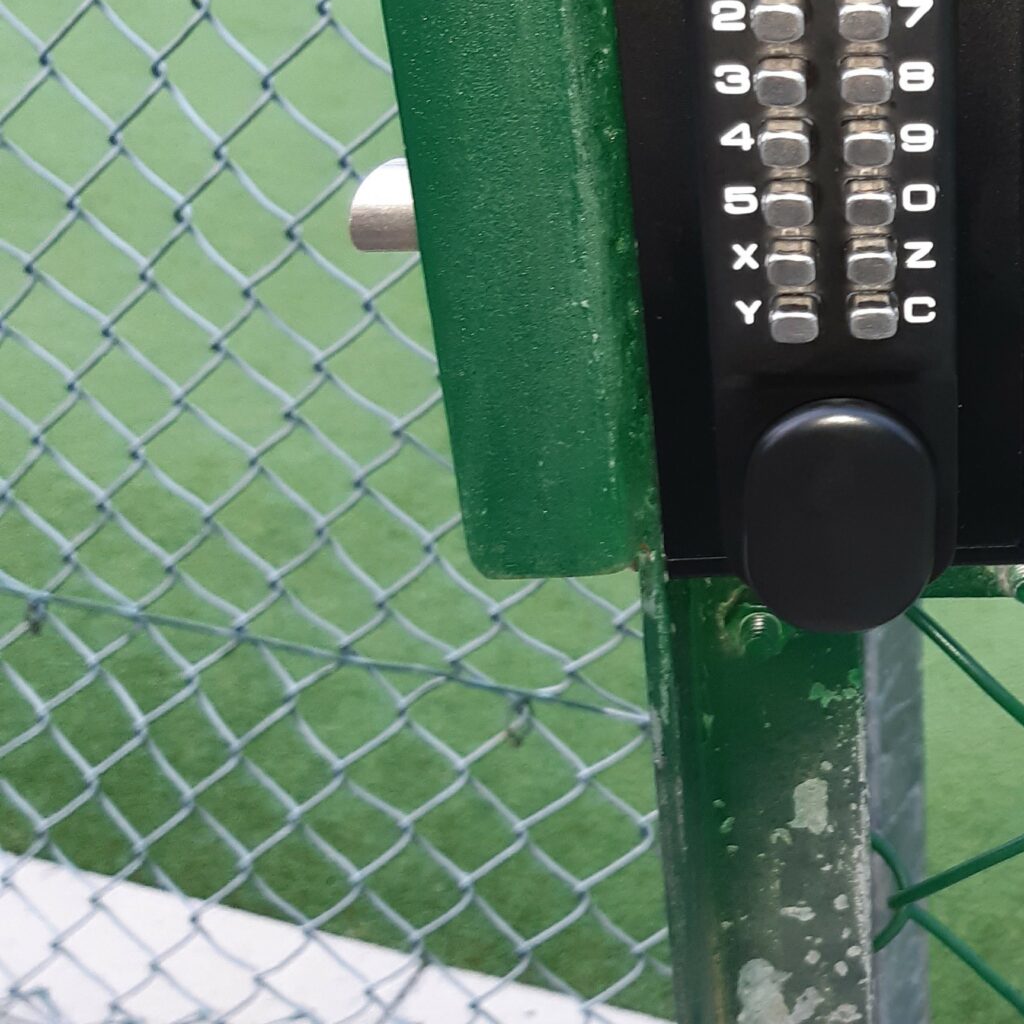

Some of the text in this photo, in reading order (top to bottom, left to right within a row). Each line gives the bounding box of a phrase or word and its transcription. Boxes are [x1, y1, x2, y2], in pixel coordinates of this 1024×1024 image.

[710, 0, 746, 31] 2
[714, 64, 751, 95] 3
[898, 61, 935, 92] 8
[720, 122, 755, 151] 4
[900, 123, 935, 152] 9
[723, 186, 758, 215] 5
[731, 243, 760, 270] X
[903, 241, 936, 269] Z
[734, 299, 762, 325] Y
[903, 296, 936, 323] C
